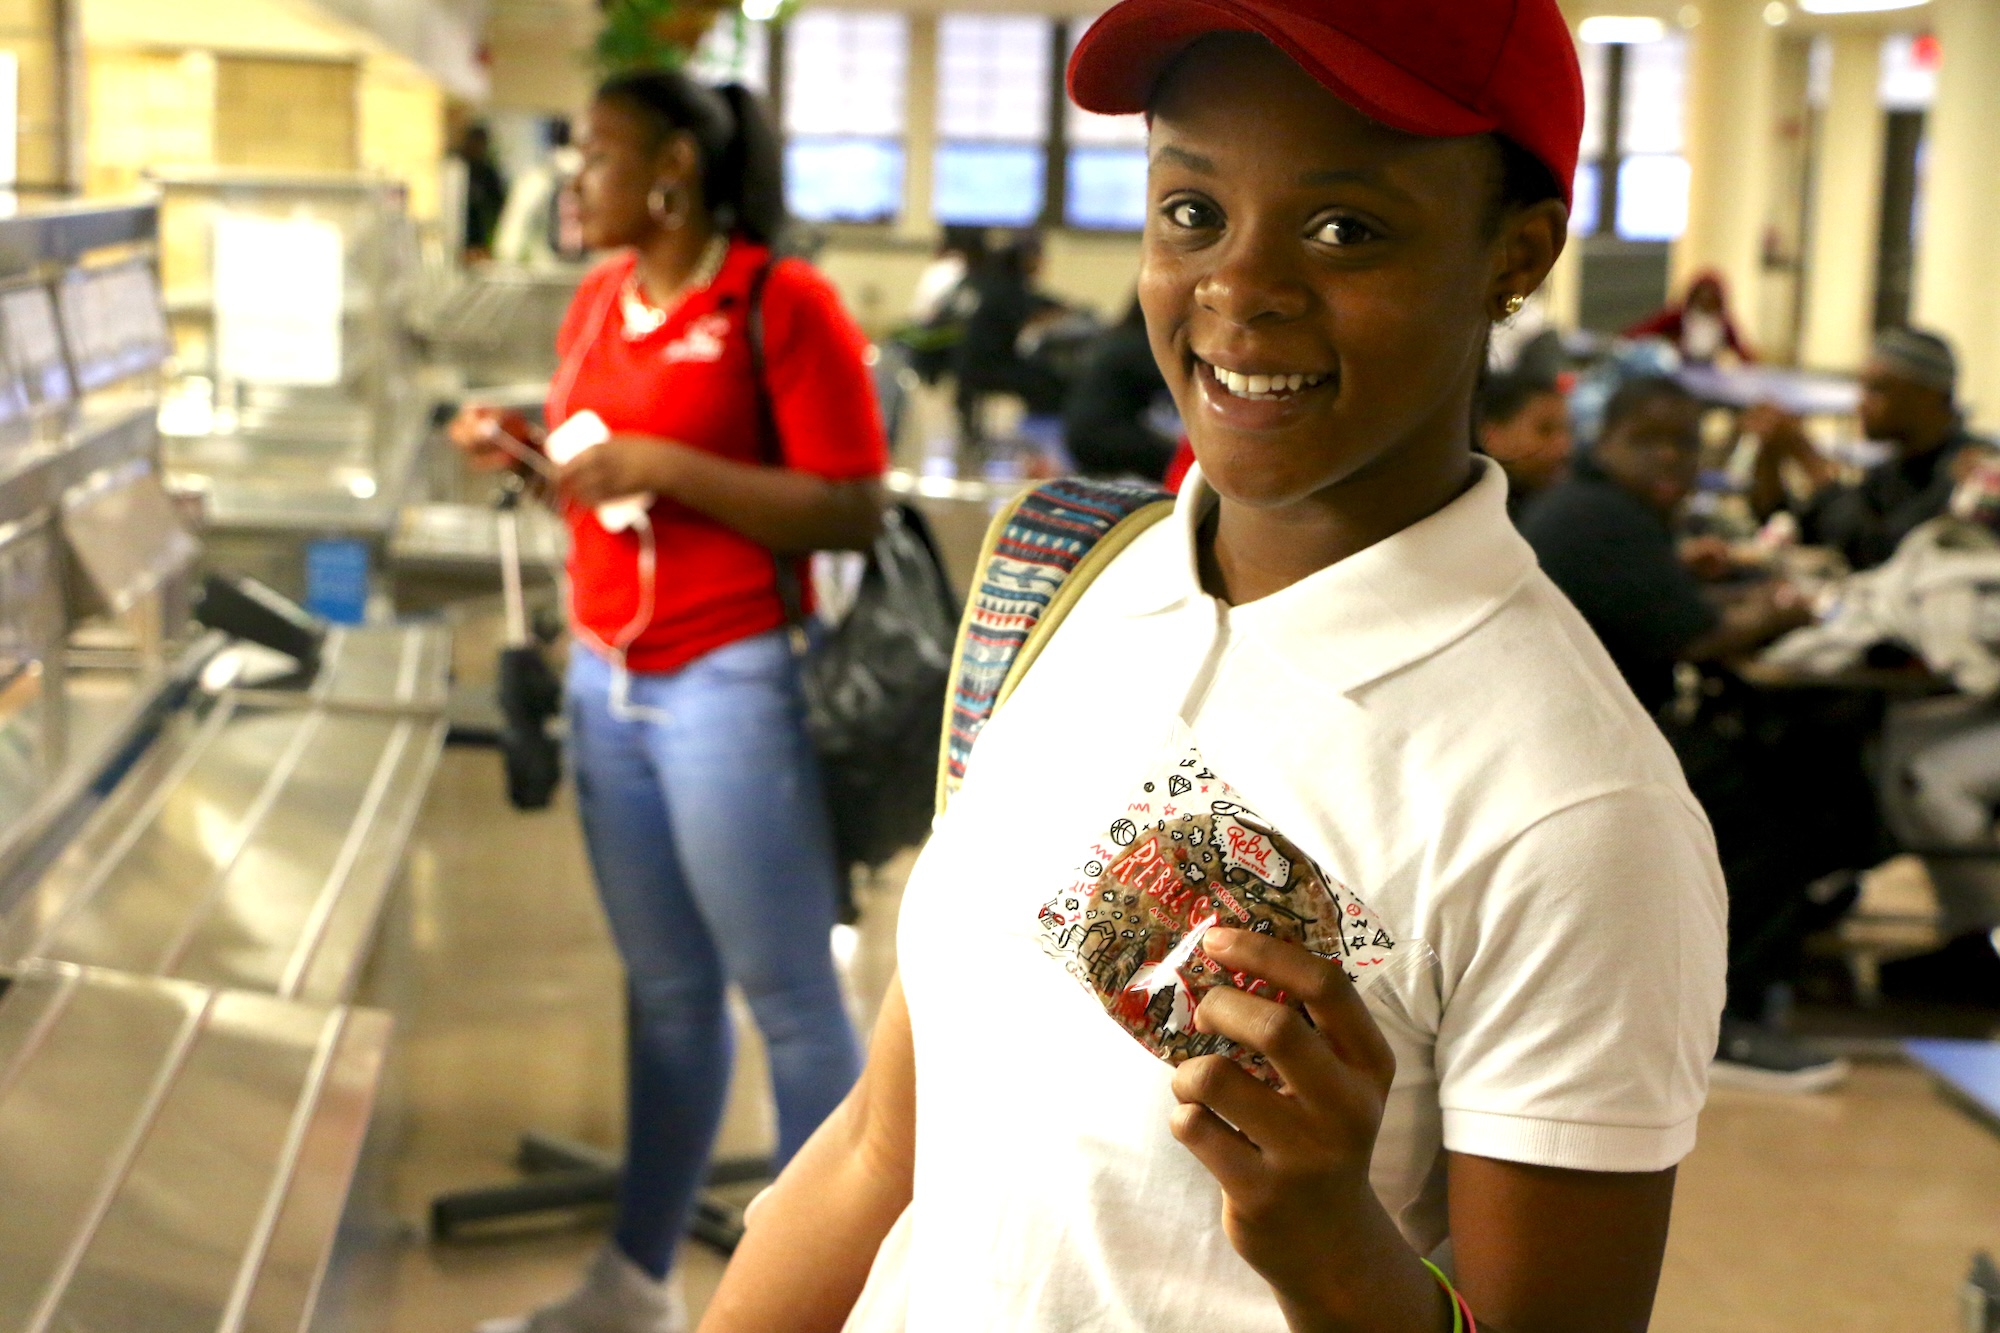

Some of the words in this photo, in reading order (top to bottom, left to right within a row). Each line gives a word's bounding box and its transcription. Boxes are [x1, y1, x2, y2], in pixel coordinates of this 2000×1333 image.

[1069, 880, 1098, 897] 215
[1111, 836, 1193, 915] REBEL
[1149, 906, 1180, 931] APPLE
[1208, 880, 1250, 923] PRESENTS
